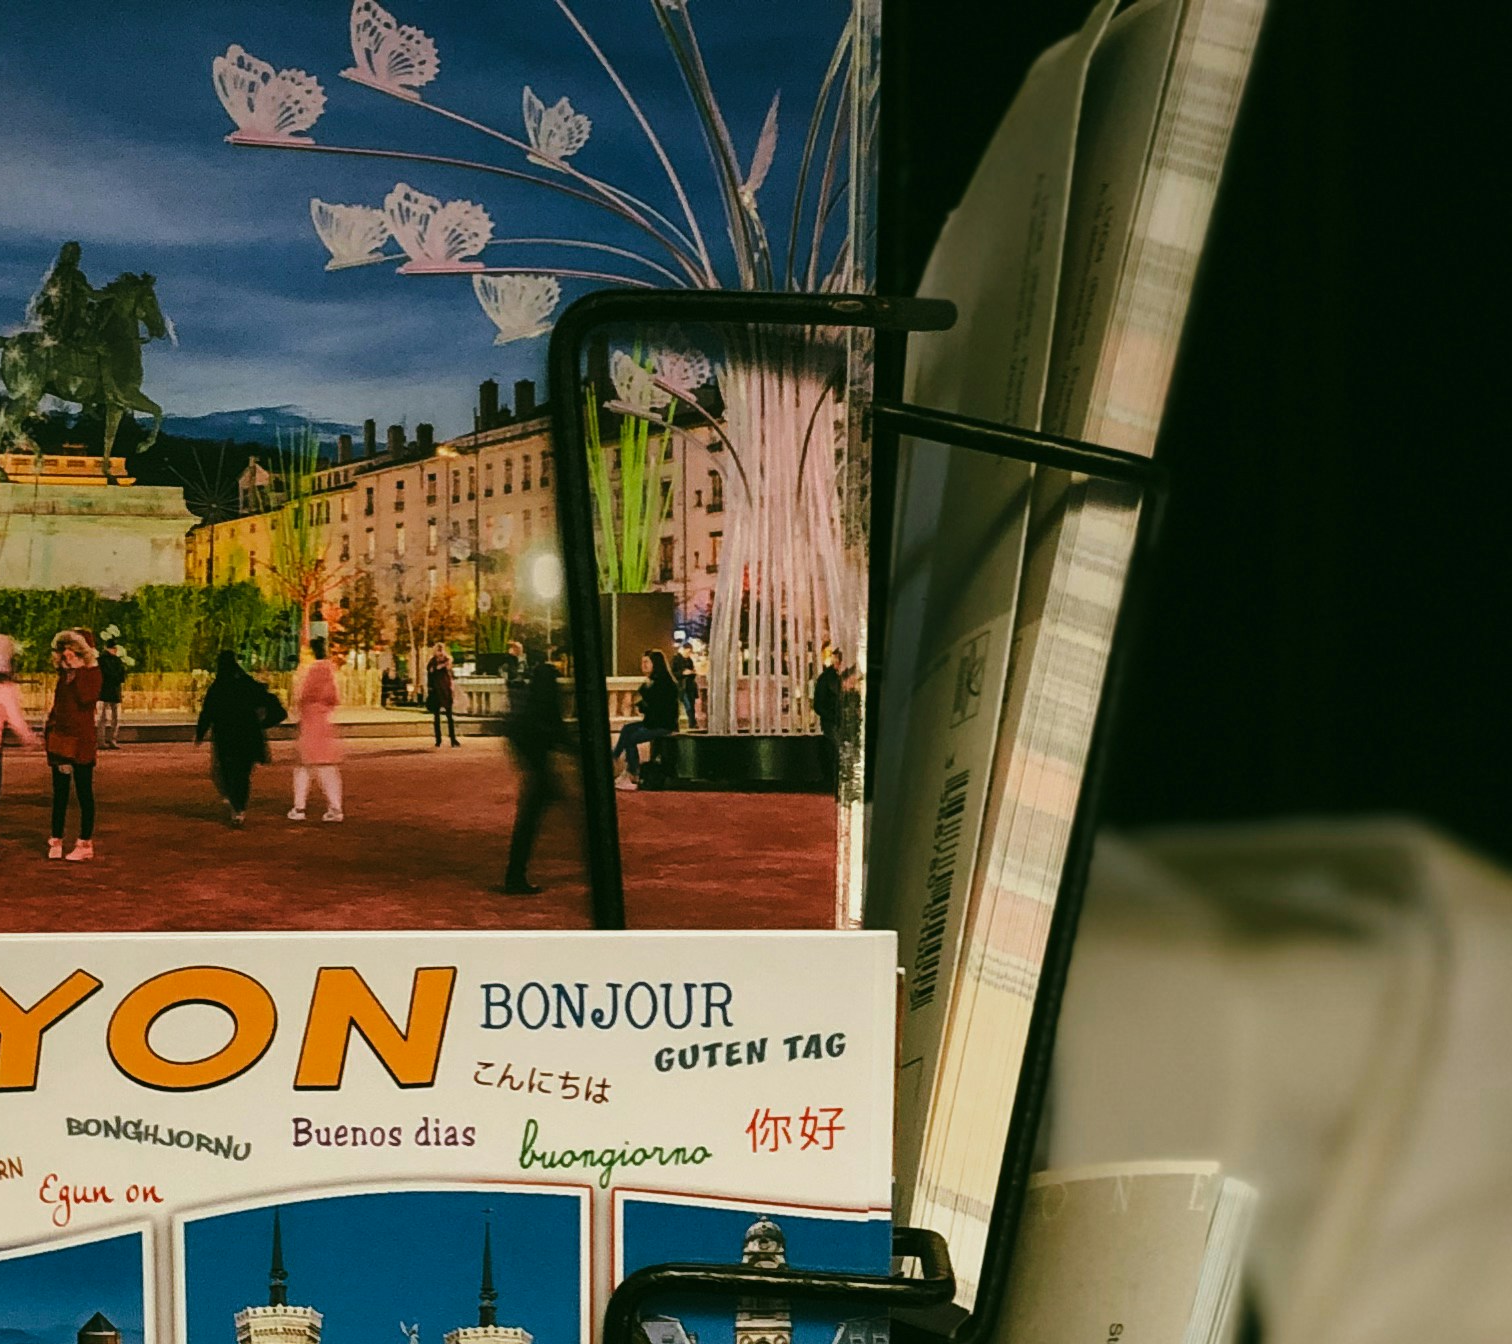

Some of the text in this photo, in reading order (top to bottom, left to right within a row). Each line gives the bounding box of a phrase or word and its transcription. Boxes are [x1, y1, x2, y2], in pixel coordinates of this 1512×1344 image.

[479, 982, 734, 1031] BONJOUR
[655, 1032, 847, 1073] GUTEN TAG
[472, 1059, 611, 1105] こんにちは
[66, 1115, 252, 1163] BONGHJORNU
[292, 1117, 403, 1149] Buenos
[519, 1118, 712, 1189] buongiorno
[745, 1105, 846, 1154] 你好
[39, 1173, 163, 1227] Egun on
